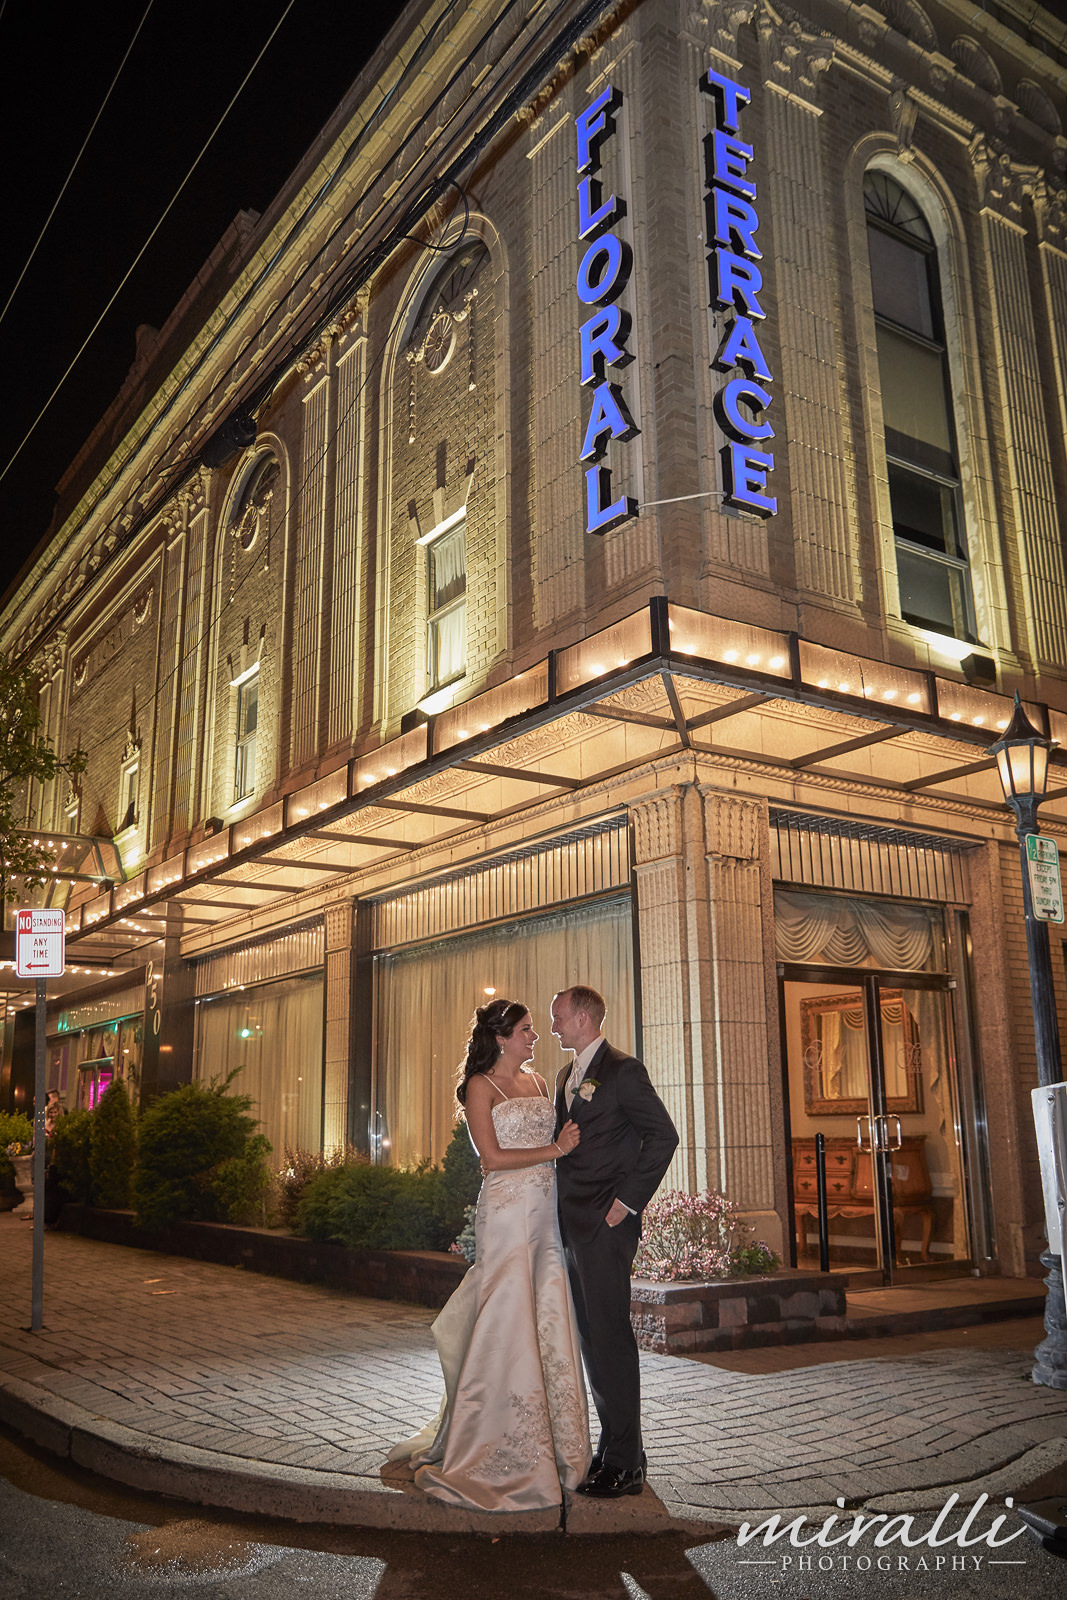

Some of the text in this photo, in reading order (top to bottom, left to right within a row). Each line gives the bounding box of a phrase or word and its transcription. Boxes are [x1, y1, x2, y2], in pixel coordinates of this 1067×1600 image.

[576, 84, 634, 535] FLORAL
[704, 67, 777, 519] TERRACE
[19, 917, 62, 930] NO STANDING
[33, 938, 48, 947] ANY
[32, 949, 48, 958] TIME
[146, 960, 161, 1036] 250
